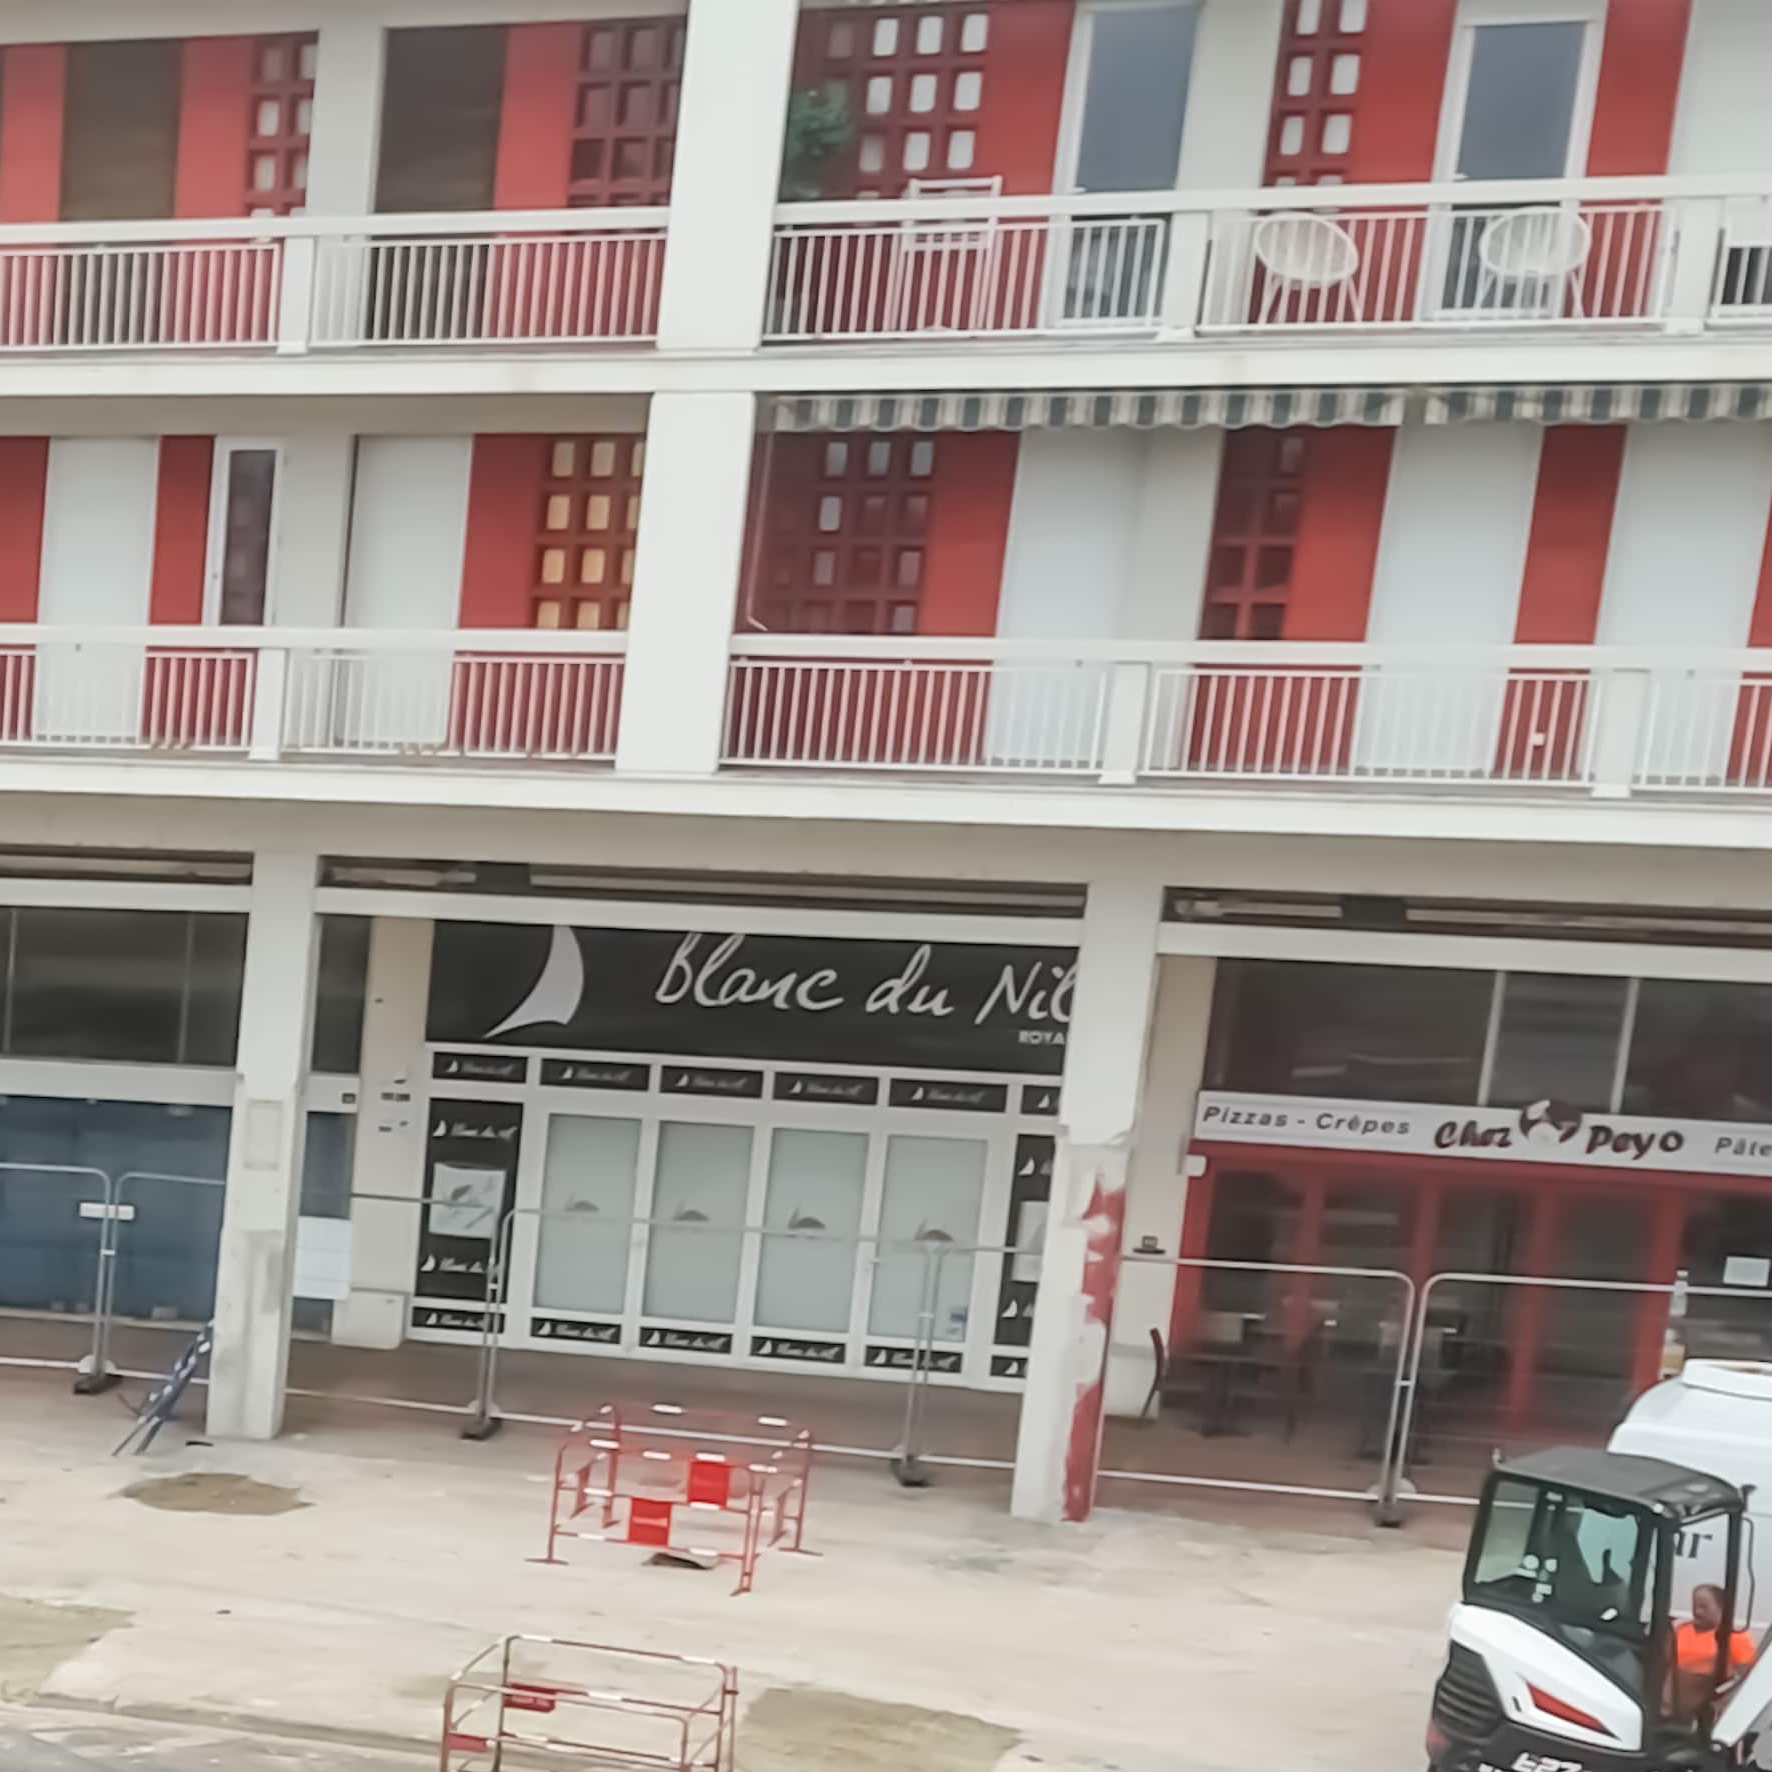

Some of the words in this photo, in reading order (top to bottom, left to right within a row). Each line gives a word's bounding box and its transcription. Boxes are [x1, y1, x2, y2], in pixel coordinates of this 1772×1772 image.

[656, 932, 844, 1010] Blanc
[865, 944, 955, 1017] du
[1203, 1106, 1289, 1128] Pizzas
[1316, 1112, 1411, 1136] Crêpes
[1585, 1124, 1685, 1161] Peyo
